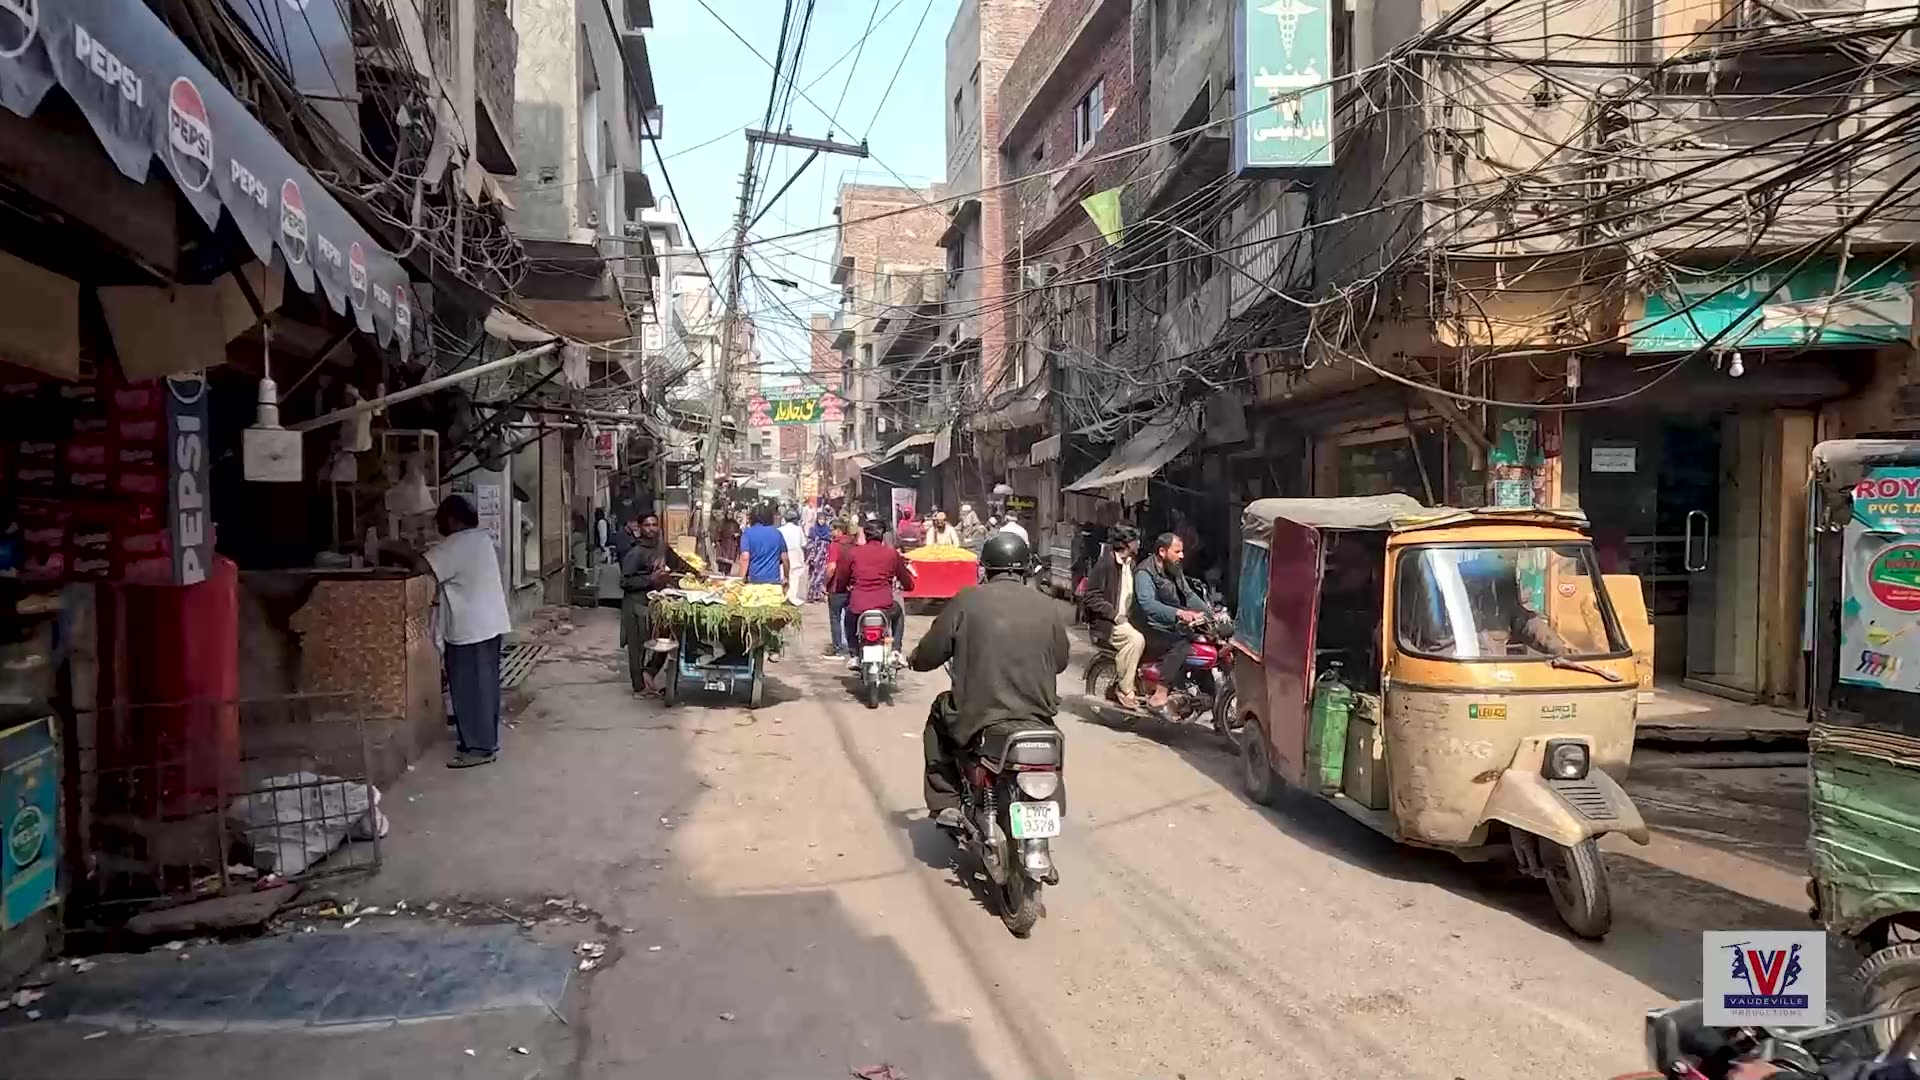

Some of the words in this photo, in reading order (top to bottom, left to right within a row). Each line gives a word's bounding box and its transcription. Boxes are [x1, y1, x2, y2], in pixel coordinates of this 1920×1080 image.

[74, 23, 144, 108] PEPSI
[170, 114, 211, 161] PEPSI
[229, 158, 269, 209] PEPSI
[177, 416, 205, 585] PEPSI
[1868, 503, 1900, 515] PVC
